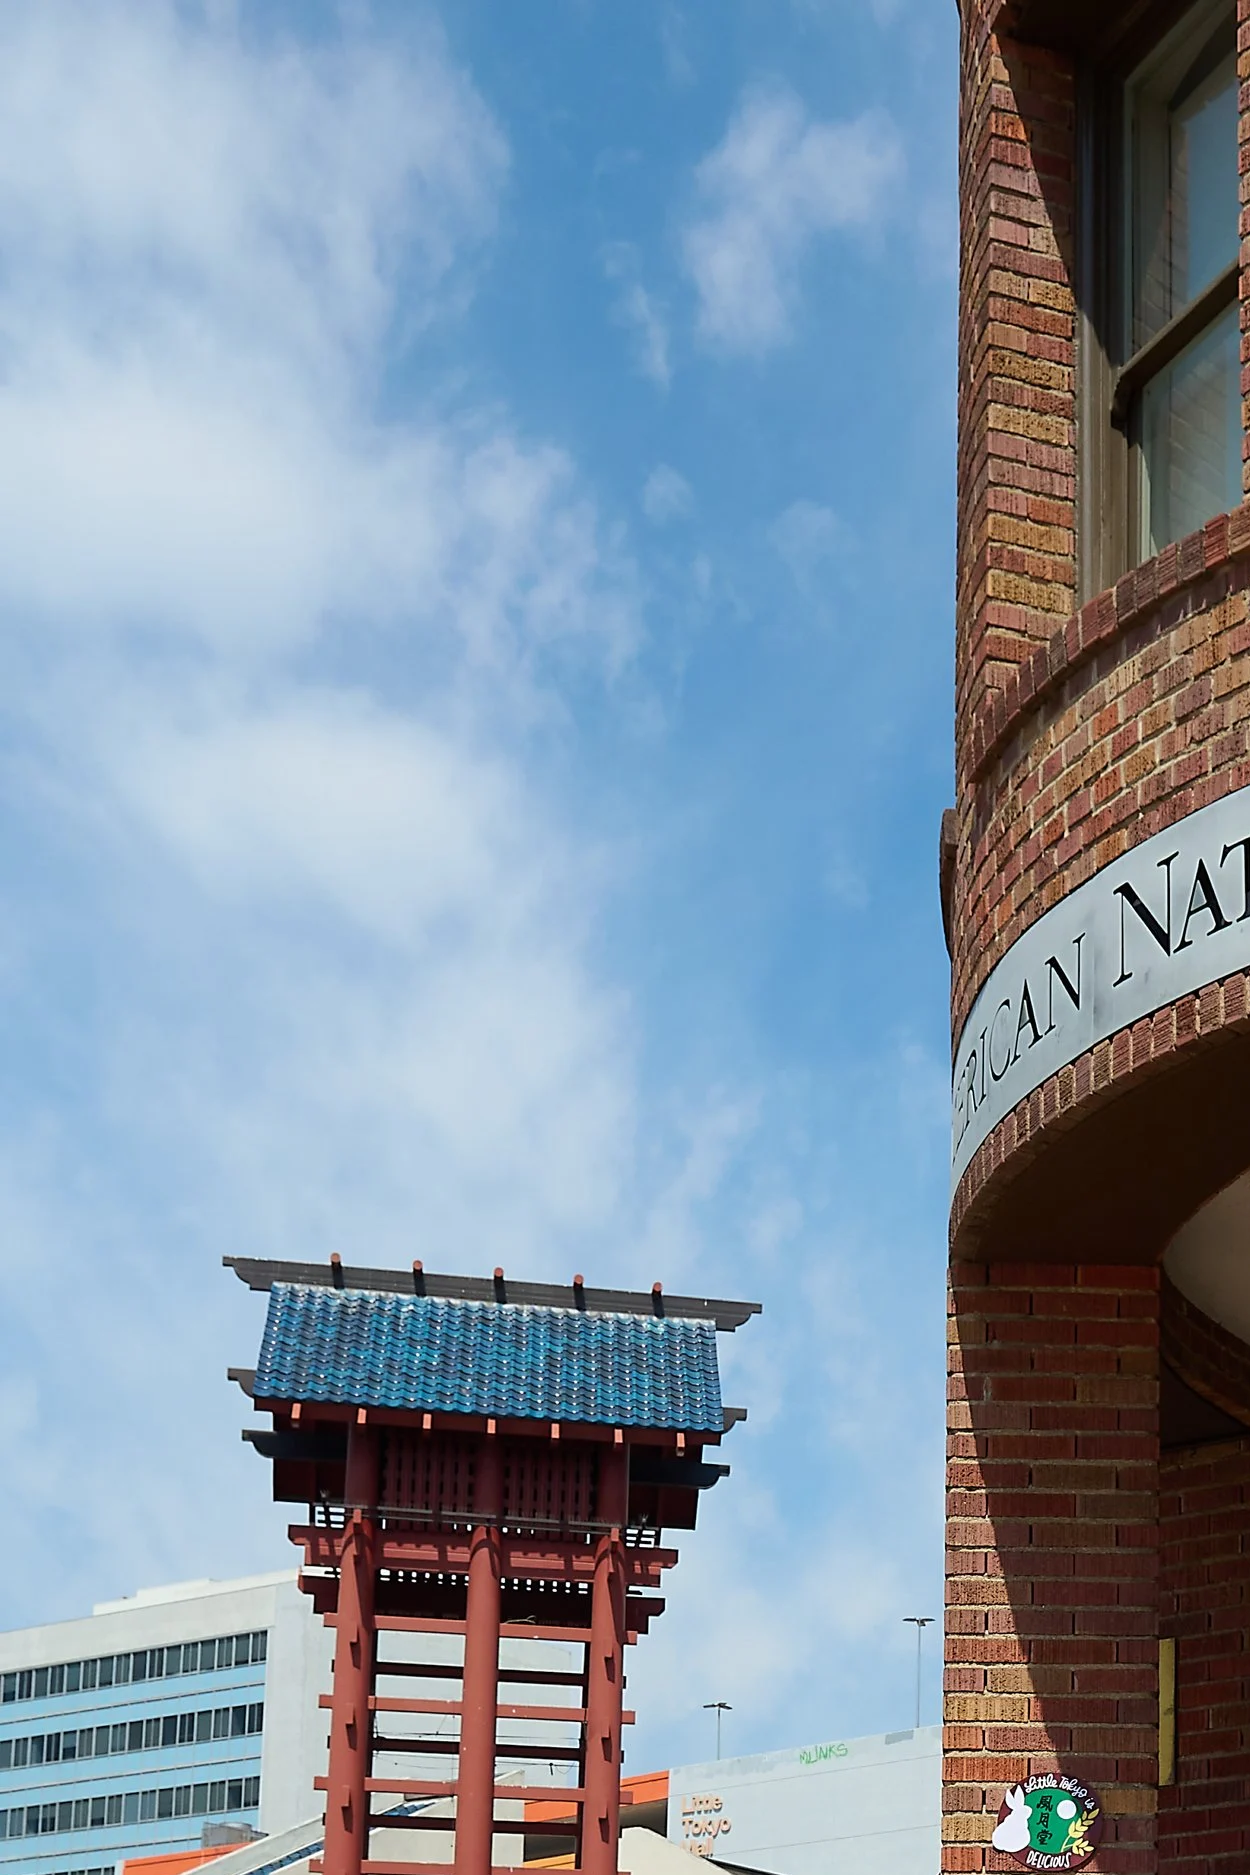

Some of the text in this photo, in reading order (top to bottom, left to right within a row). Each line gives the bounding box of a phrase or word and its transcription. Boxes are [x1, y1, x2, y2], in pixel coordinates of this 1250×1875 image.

[1024, 1774, 1095, 1810] Little Tokyo is
[681, 1794, 723, 1817] Little
[681, 1817, 731, 1839] Tokyo
[1026, 1850, 1071, 1869] DELICIOUS
